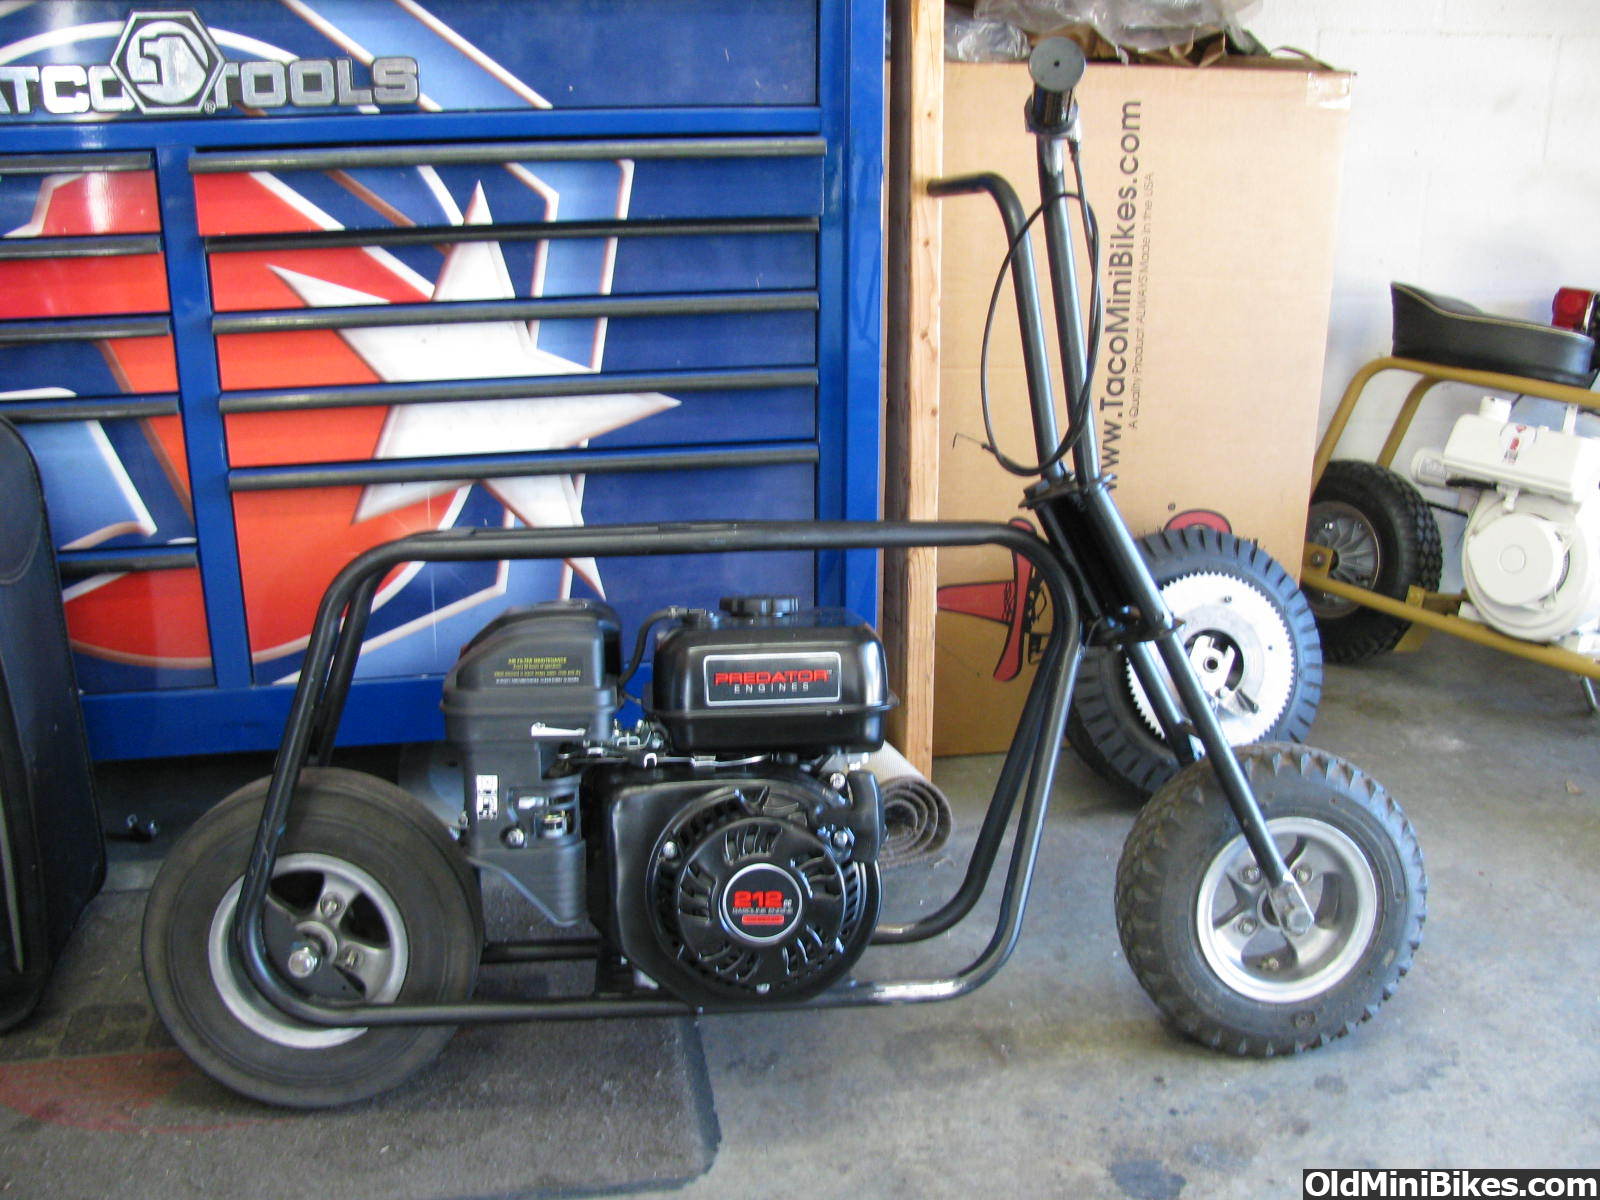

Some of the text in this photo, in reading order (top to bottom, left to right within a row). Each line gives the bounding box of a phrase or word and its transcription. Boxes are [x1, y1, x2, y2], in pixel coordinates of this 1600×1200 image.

[0, 57, 420, 114] TCO TOOLS
[1132, 326, 1144, 374] Product
[1129, 378, 1142, 417] Quality
[715, 669, 829, 686] PREDATOR
[734, 682, 809, 694] ENGINES
[733, 890, 784, 909] 212
